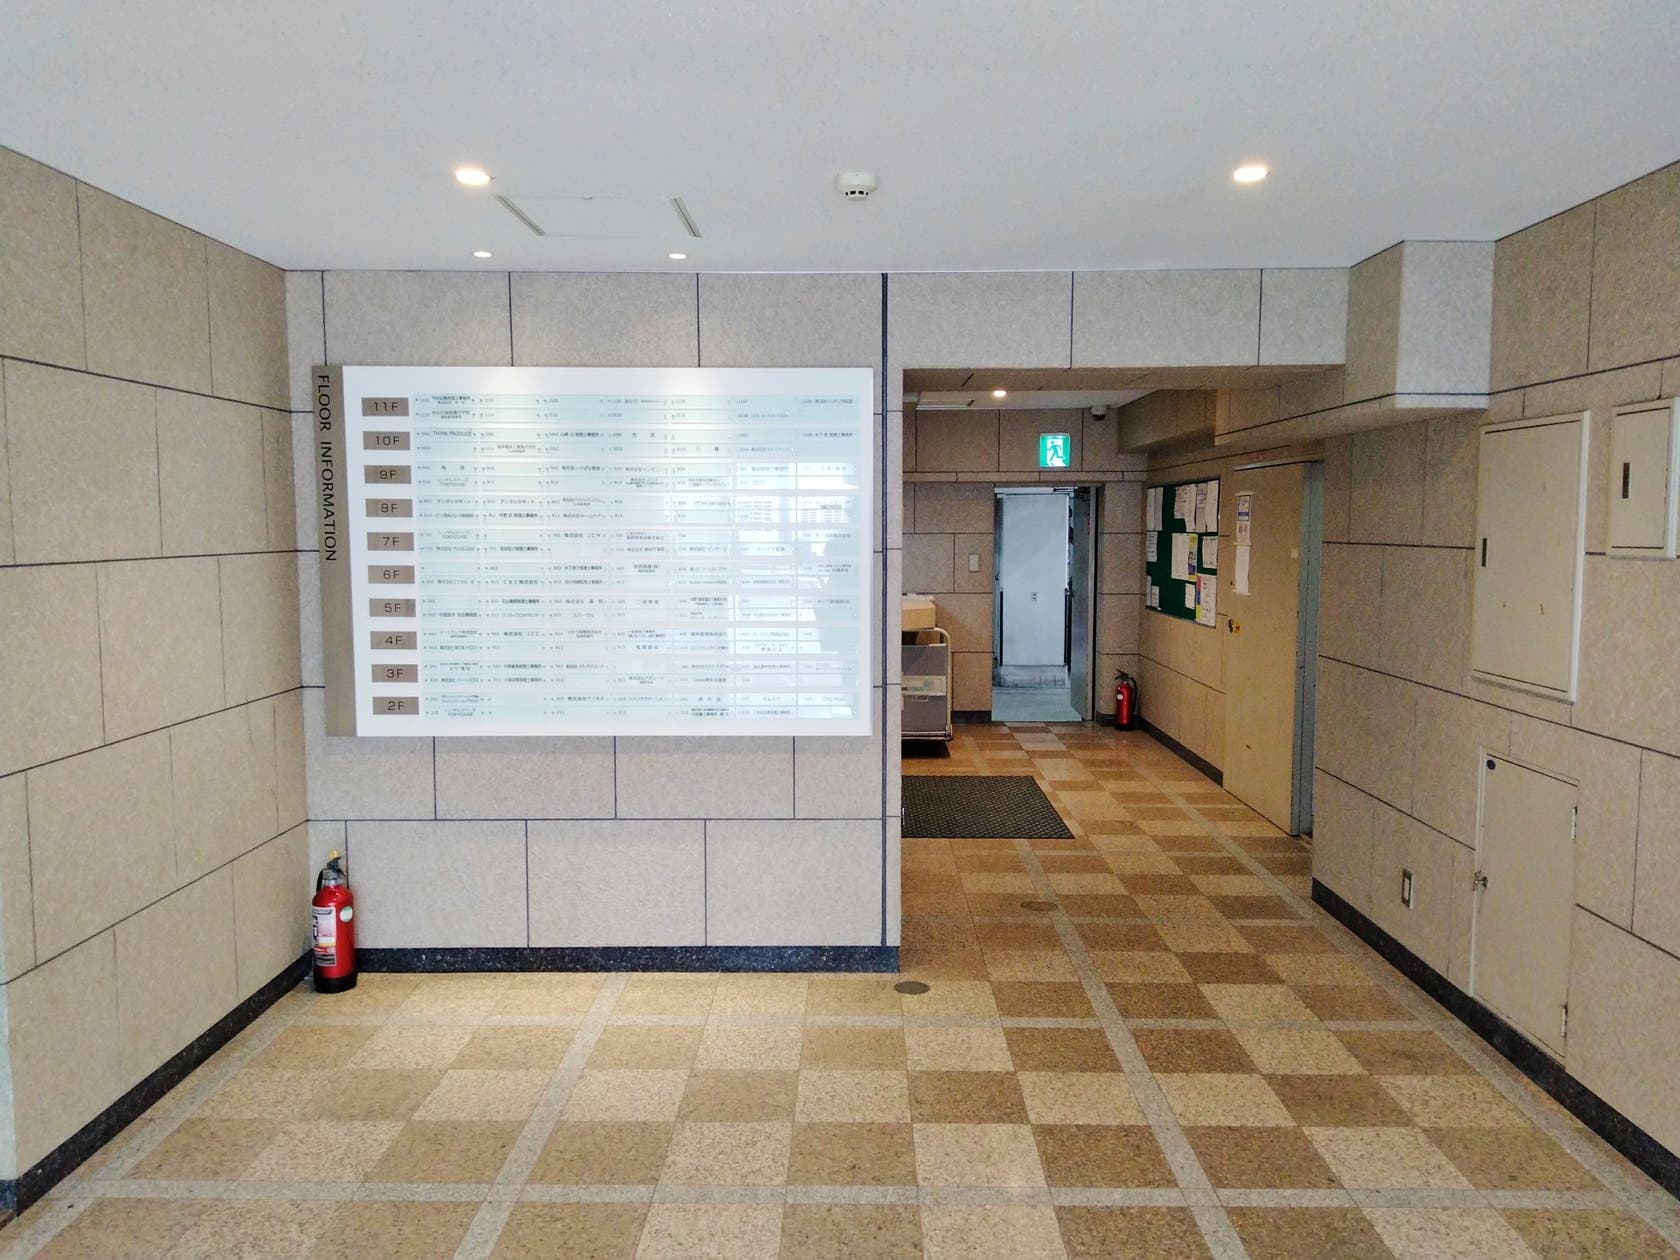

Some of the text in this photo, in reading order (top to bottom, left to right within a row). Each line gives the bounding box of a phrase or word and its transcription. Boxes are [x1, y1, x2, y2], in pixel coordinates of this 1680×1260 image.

[373, 401, 399, 412] 11F
[375, 435, 401, 446] 10F
[317, 375, 337, 561] FLOOR INFORMATION
[379, 469, 398, 480] 9F
[381, 503, 399, 514] 8F
[381, 536, 400, 547] 7F
[383, 569, 401, 580] 6F
[384, 602, 401, 613] 5F
[384, 635, 402, 645] 4F
[386, 668, 404, 679] 3F
[387, 701, 405, 711] 2F
